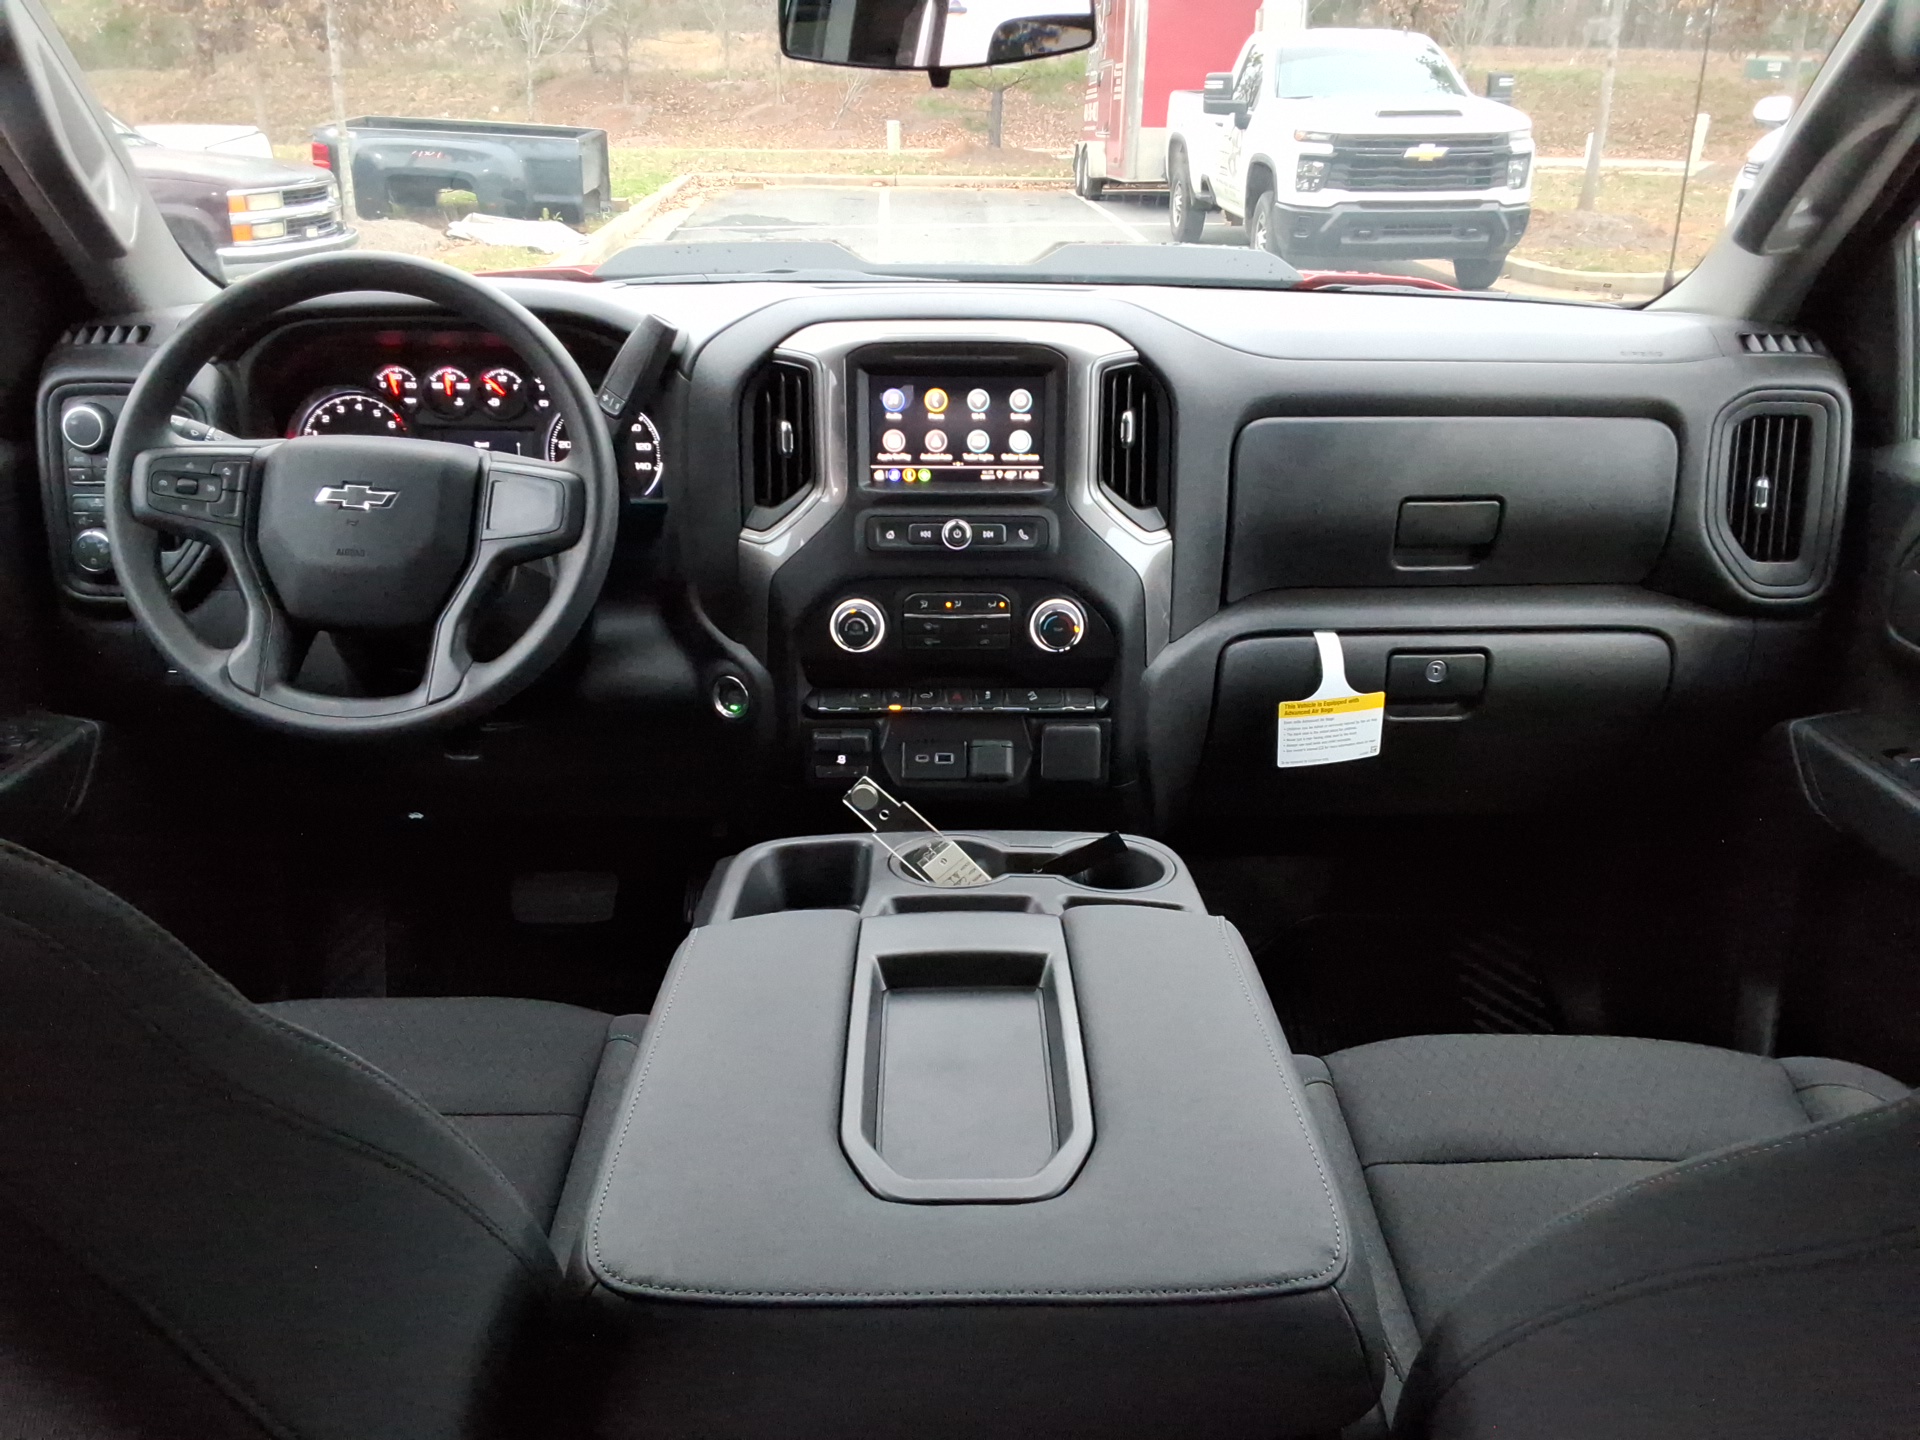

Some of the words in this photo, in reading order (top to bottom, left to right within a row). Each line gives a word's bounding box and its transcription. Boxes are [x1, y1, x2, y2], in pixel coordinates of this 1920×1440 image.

[336, 405, 345, 414] 3
[354, 403, 362, 411] 4
[373, 409, 382, 417] 5
[321, 415, 330, 423] 2
[387, 421, 396, 429] 6
